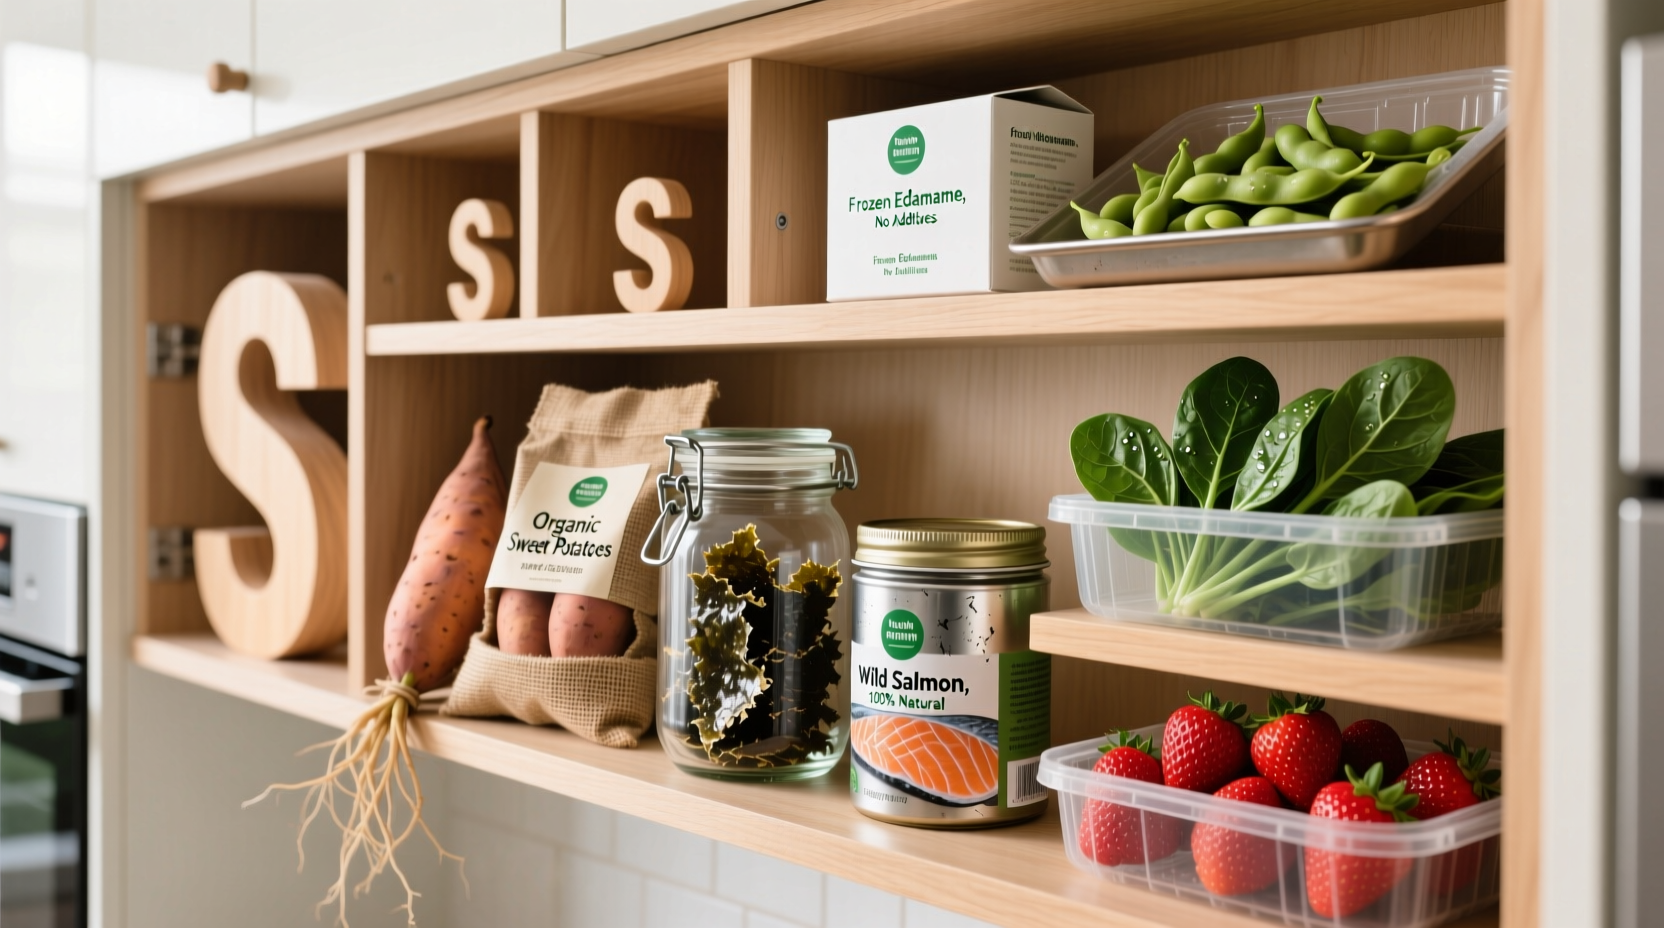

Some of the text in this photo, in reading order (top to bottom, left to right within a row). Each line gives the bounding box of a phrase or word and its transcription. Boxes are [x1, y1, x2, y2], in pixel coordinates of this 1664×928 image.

[849, 196, 891, 212] Frozen
[875, 215, 890, 228] No
[532, 511, 601, 538] Organic
[858, 664, 970, 696] Wild Salmon,
[868, 691, 945, 711] 100% Natural
